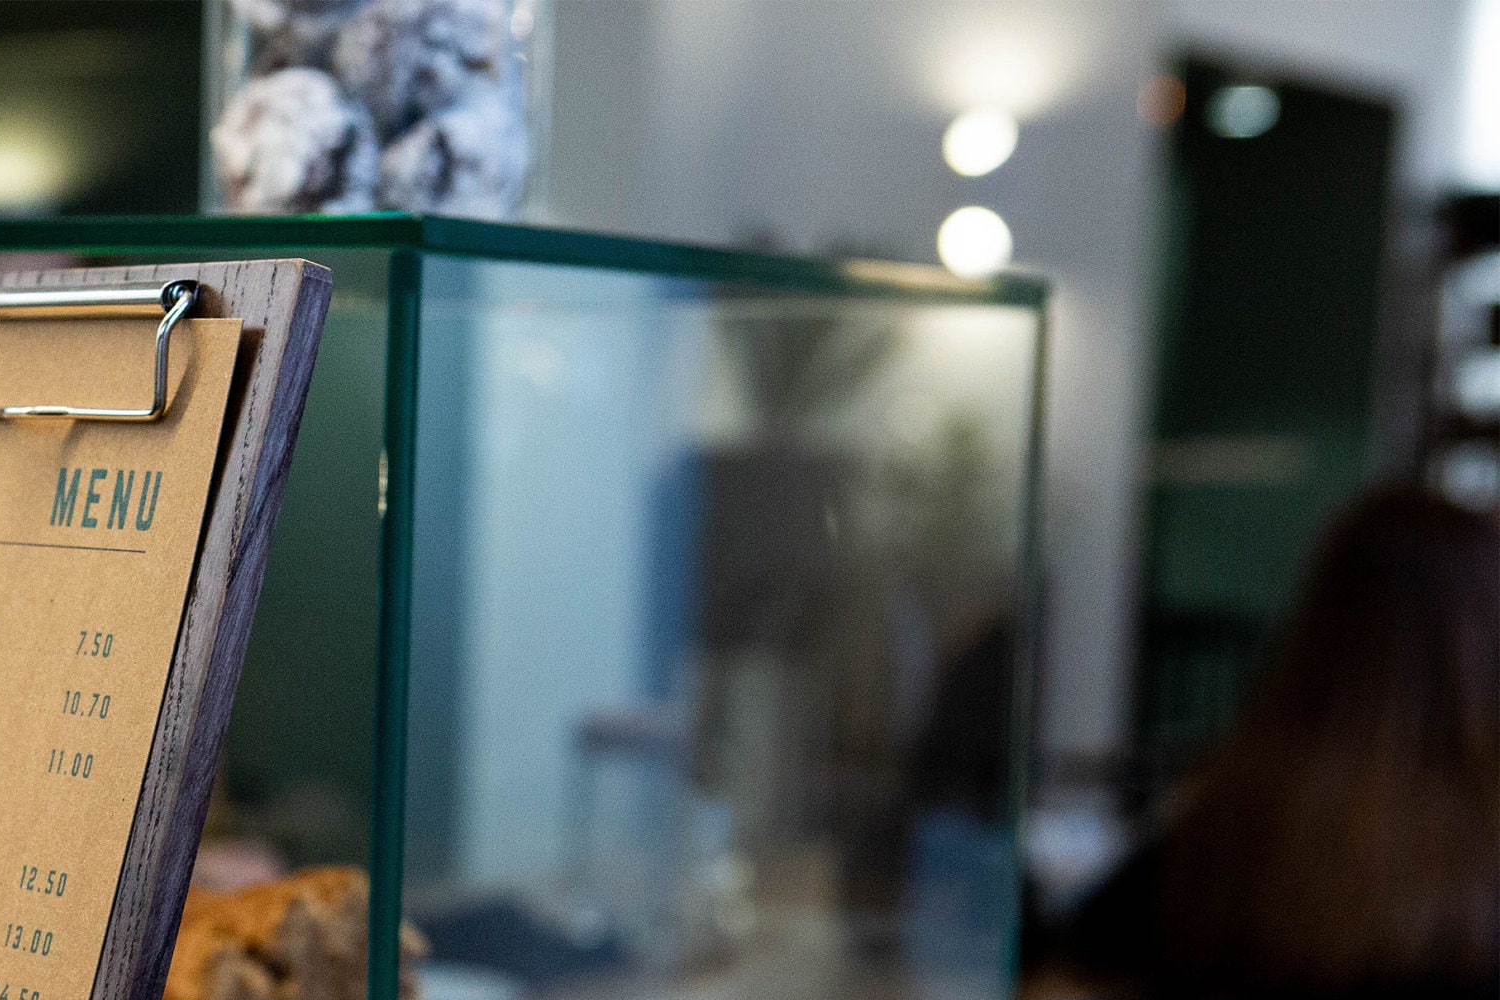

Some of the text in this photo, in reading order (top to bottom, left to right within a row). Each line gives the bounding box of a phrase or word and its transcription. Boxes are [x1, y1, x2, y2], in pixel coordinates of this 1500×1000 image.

[49, 467, 162, 532] MENU
[75, 630, 114, 659] 7.50
[62, 690, 112, 720] 10.70
[48, 749, 94, 780] 11.00
[18, 864, 68, 898] 12.50
[4, 922, 53, 957] 13.00
